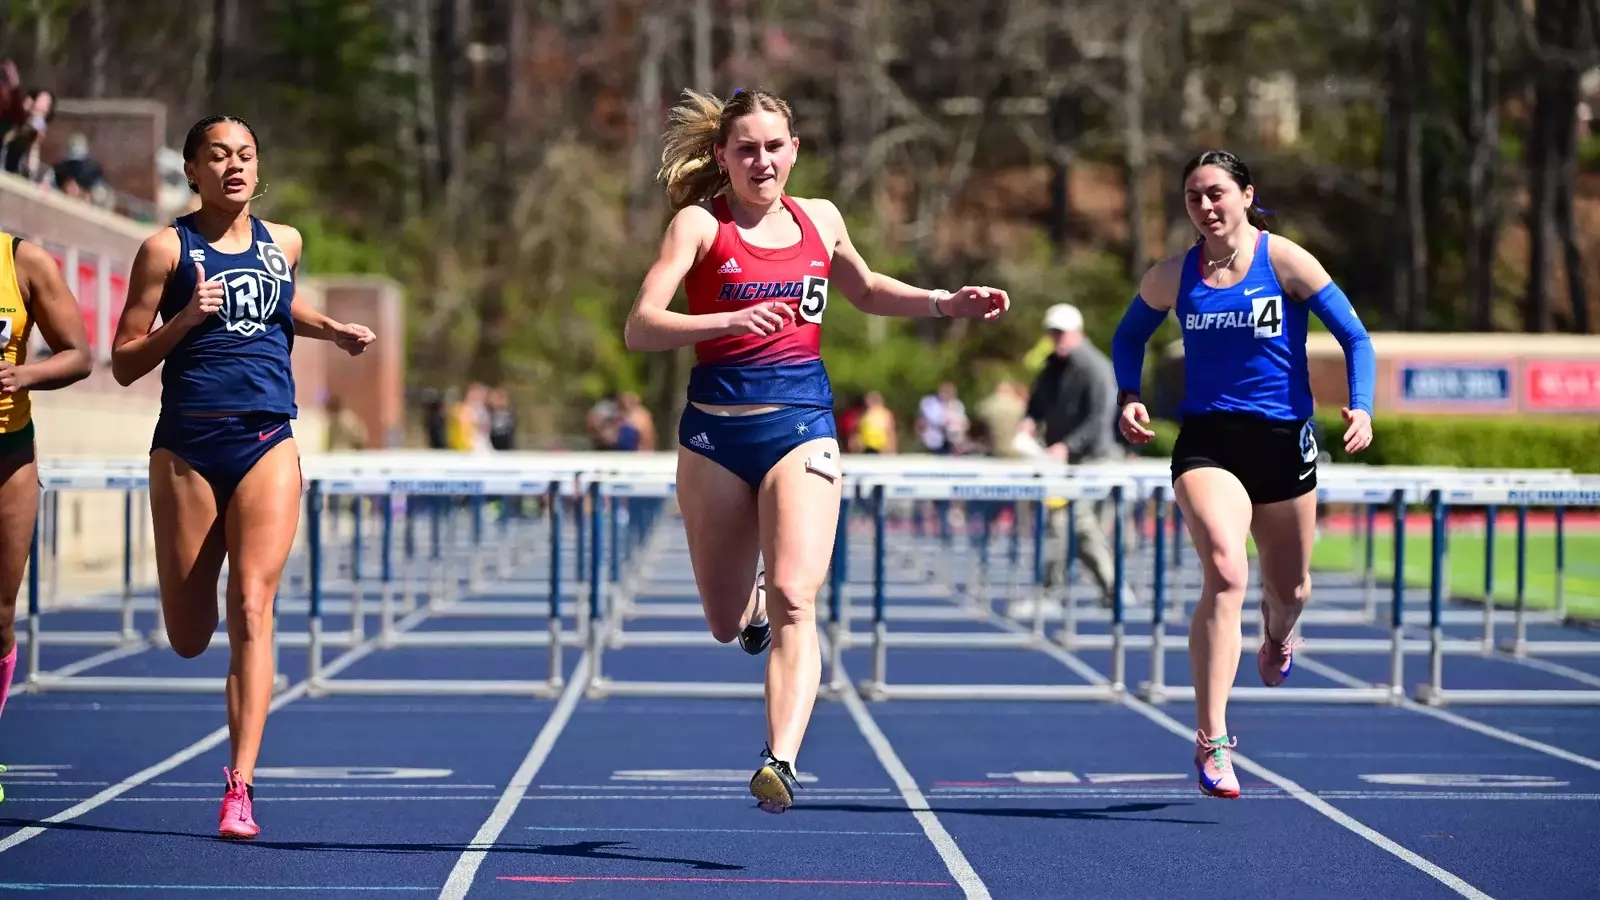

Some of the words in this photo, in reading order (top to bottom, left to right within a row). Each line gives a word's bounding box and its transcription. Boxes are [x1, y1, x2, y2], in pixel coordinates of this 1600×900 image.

[263, 245, 287, 276] 6
[718, 266, 742, 274] adidas
[228, 274, 259, 318] R
[716, 281, 804, 301] RICHMO
[802, 277, 826, 316] 5
[1257, 299, 1281, 333] 4
[689, 438, 715, 451] adidas
